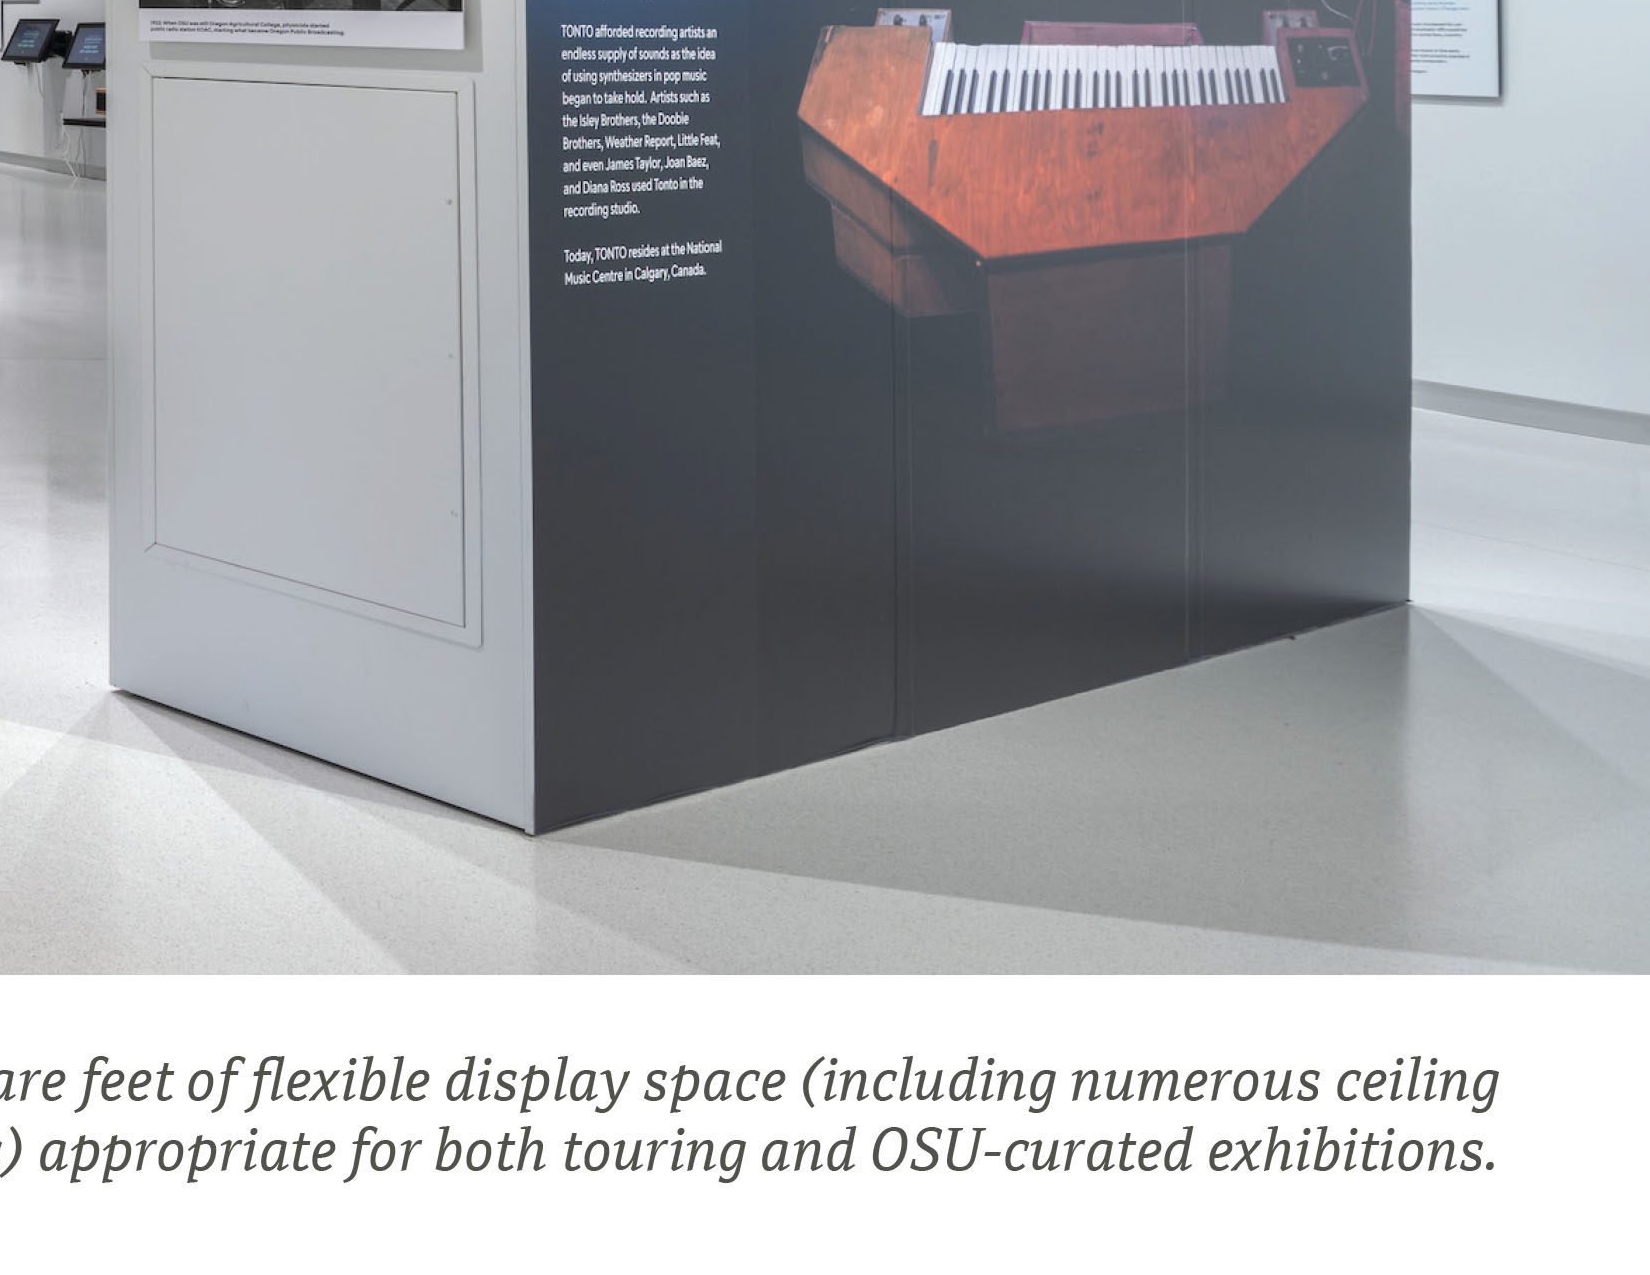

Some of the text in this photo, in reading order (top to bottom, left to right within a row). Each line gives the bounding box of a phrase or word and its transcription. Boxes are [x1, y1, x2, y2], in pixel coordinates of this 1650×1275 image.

[562, 25, 717, 41] TONTO afforded recording artists an
[562, 68, 708, 86] of using synthesizers in pop music
[562, 90, 710, 108] began to take hold. Artists such as
[562, 112, 690, 130] the Isley Brothers, the Doobie
[563, 133, 720, 151] Brothers, Weather Report, Little Feat,
[563, 154, 710, 173] and even James Taylor, Joan Baez,
[564, 176, 704, 195] and Diana Ross used Tonto in the
[564, 201, 640, 221] recording studio.
[565, 240, 723, 266] Today, TONTO resides at the National
[564, 263, 707, 285] Music Centre in Calgary, Canada.
